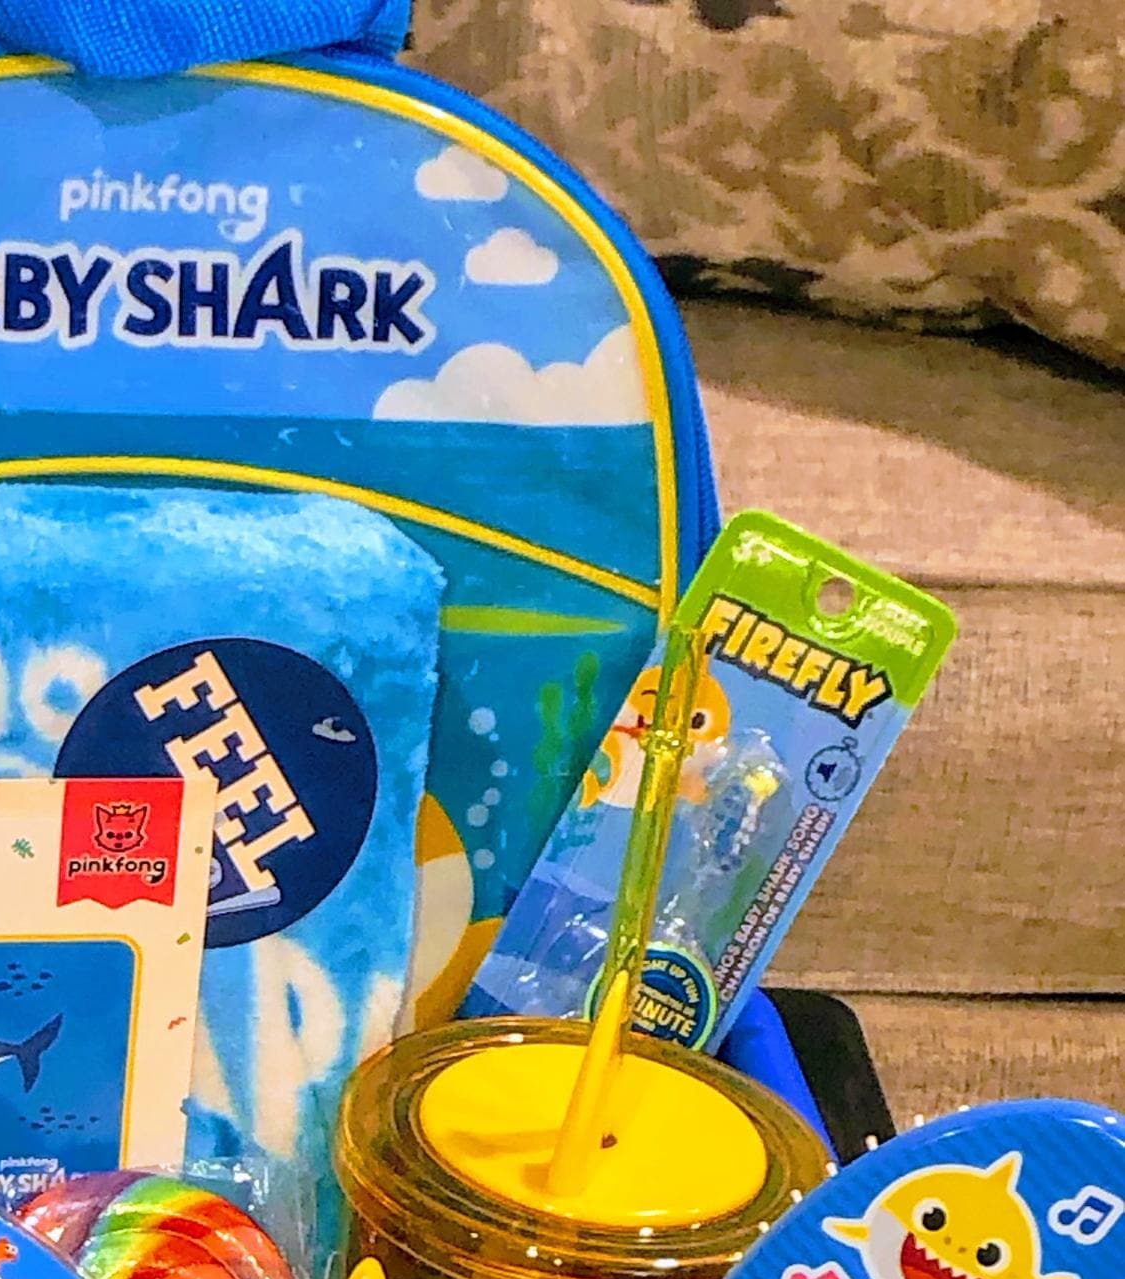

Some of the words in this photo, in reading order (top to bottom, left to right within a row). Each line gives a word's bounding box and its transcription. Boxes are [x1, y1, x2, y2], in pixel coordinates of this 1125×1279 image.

[59, 168, 269, 242] pinkfong
[123, 240, 427, 345] SHARK
[700, 596, 889, 722] FIREFLY
[133, 650, 317, 892] FEEL
[68, 856, 166, 884] pinkfong
[0, 1156, 59, 1173] pinkfong
